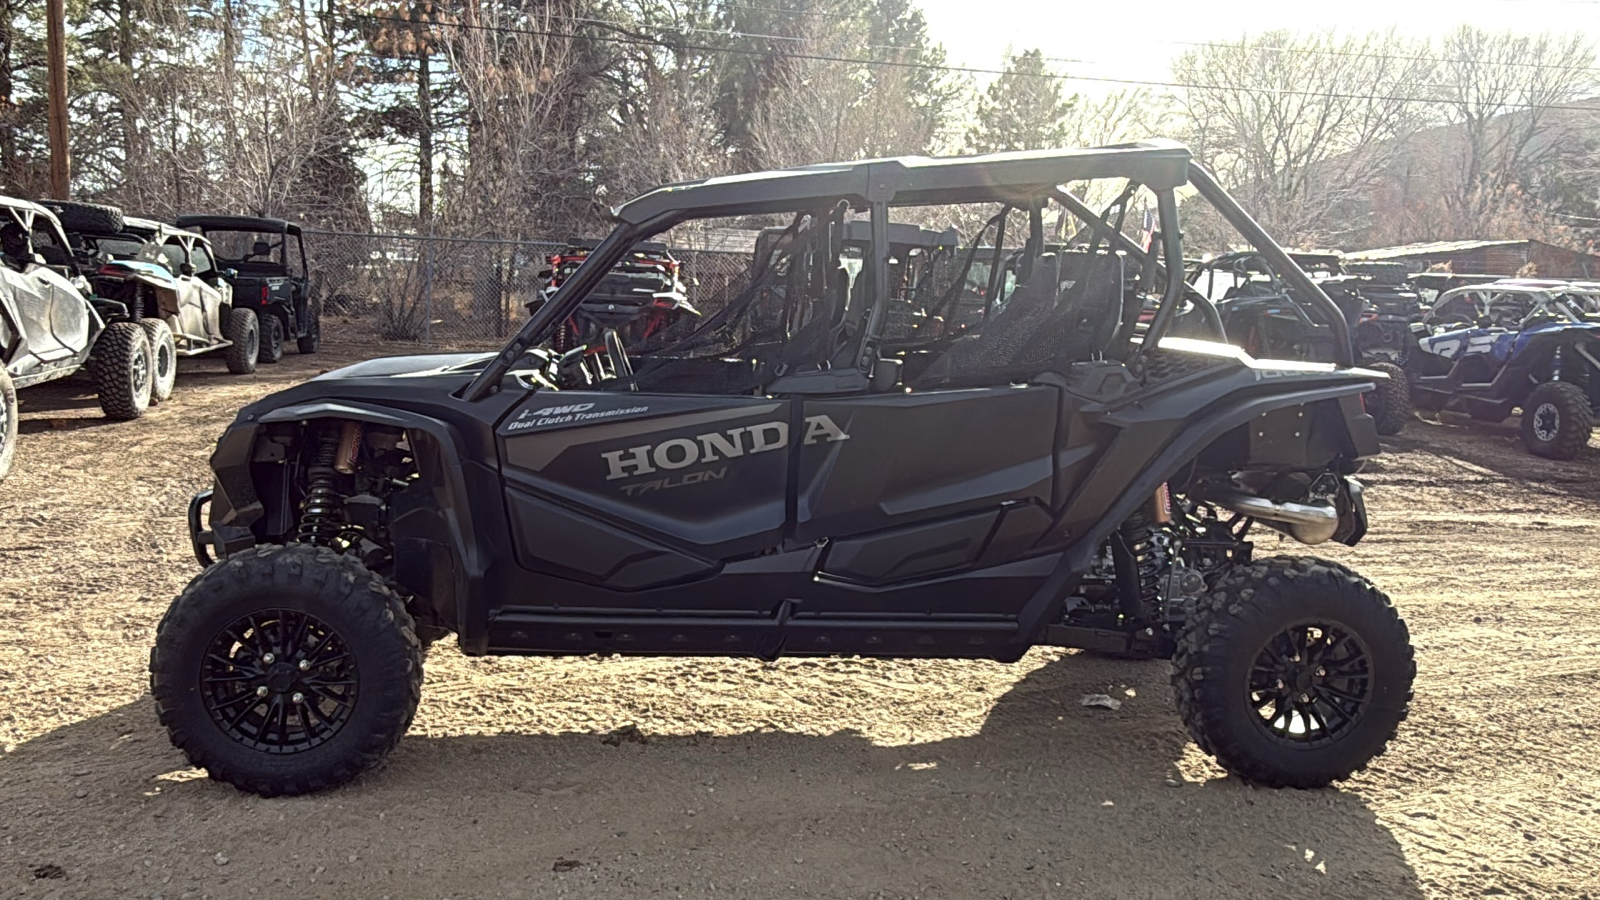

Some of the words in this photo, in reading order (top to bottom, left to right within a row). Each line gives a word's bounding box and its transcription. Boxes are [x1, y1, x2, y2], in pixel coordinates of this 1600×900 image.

[507, 420, 535, 430] Dual
[536, 413, 573, 426] Clutch
[574, 406, 649, 421] Transmission
[518, 402, 595, 419] i-4WD
[601, 414, 850, 480] HONDA
[620, 467, 727, 497] TALON
